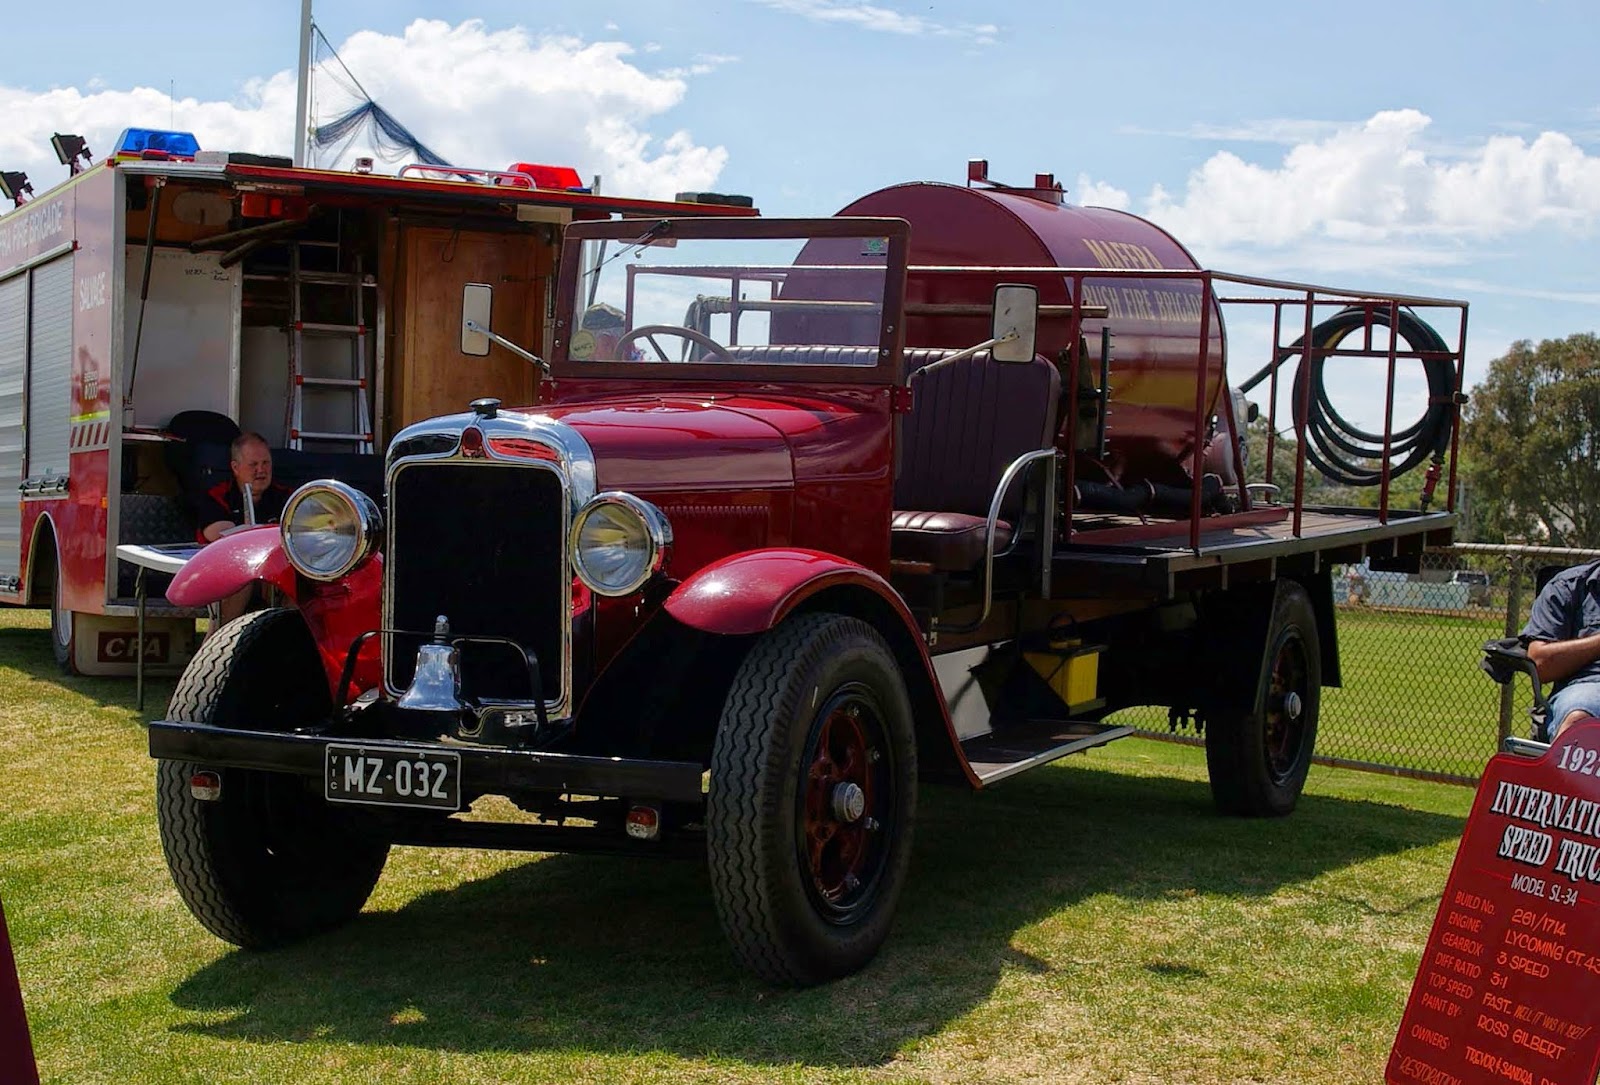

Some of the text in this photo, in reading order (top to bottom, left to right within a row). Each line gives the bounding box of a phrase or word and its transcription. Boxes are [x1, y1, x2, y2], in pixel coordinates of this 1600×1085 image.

[30, 200, 64, 243] BRIGADE
[1082, 238, 1164, 269] MAFFRA
[80, 271, 105, 311] SALVAGE
[1081, 284, 1123, 318] BUSH
[1121, 287, 1155, 319] FIRE
[105, 637, 160, 657] CFA
[330, 755, 338, 790] VIC
[1499, 824, 1600, 882] SPEED TRUC
[1454, 891, 1481, 909] BUILD
[1480, 898, 1496, 916] No.
[1511, 873, 1579, 907] MODEL SL-34
[1504, 928, 1565, 961] LYCOMING
[1428, 971, 1447, 990] TOP
[1434, 952, 1455, 969] DIFF
[1490, 971, 1509, 989] 3:1
[1497, 951, 1507, 965] 3
[1509, 955, 1550, 979] SPEED
[1421, 992, 1449, 1013] PAINT
[1477, 1014, 1510, 1039] ROSS
[1512, 1028, 1567, 1061] GILBERT
[1465, 1045, 1497, 1073] TREVOR
[1500, 1061, 1534, 1085] SANDRA
